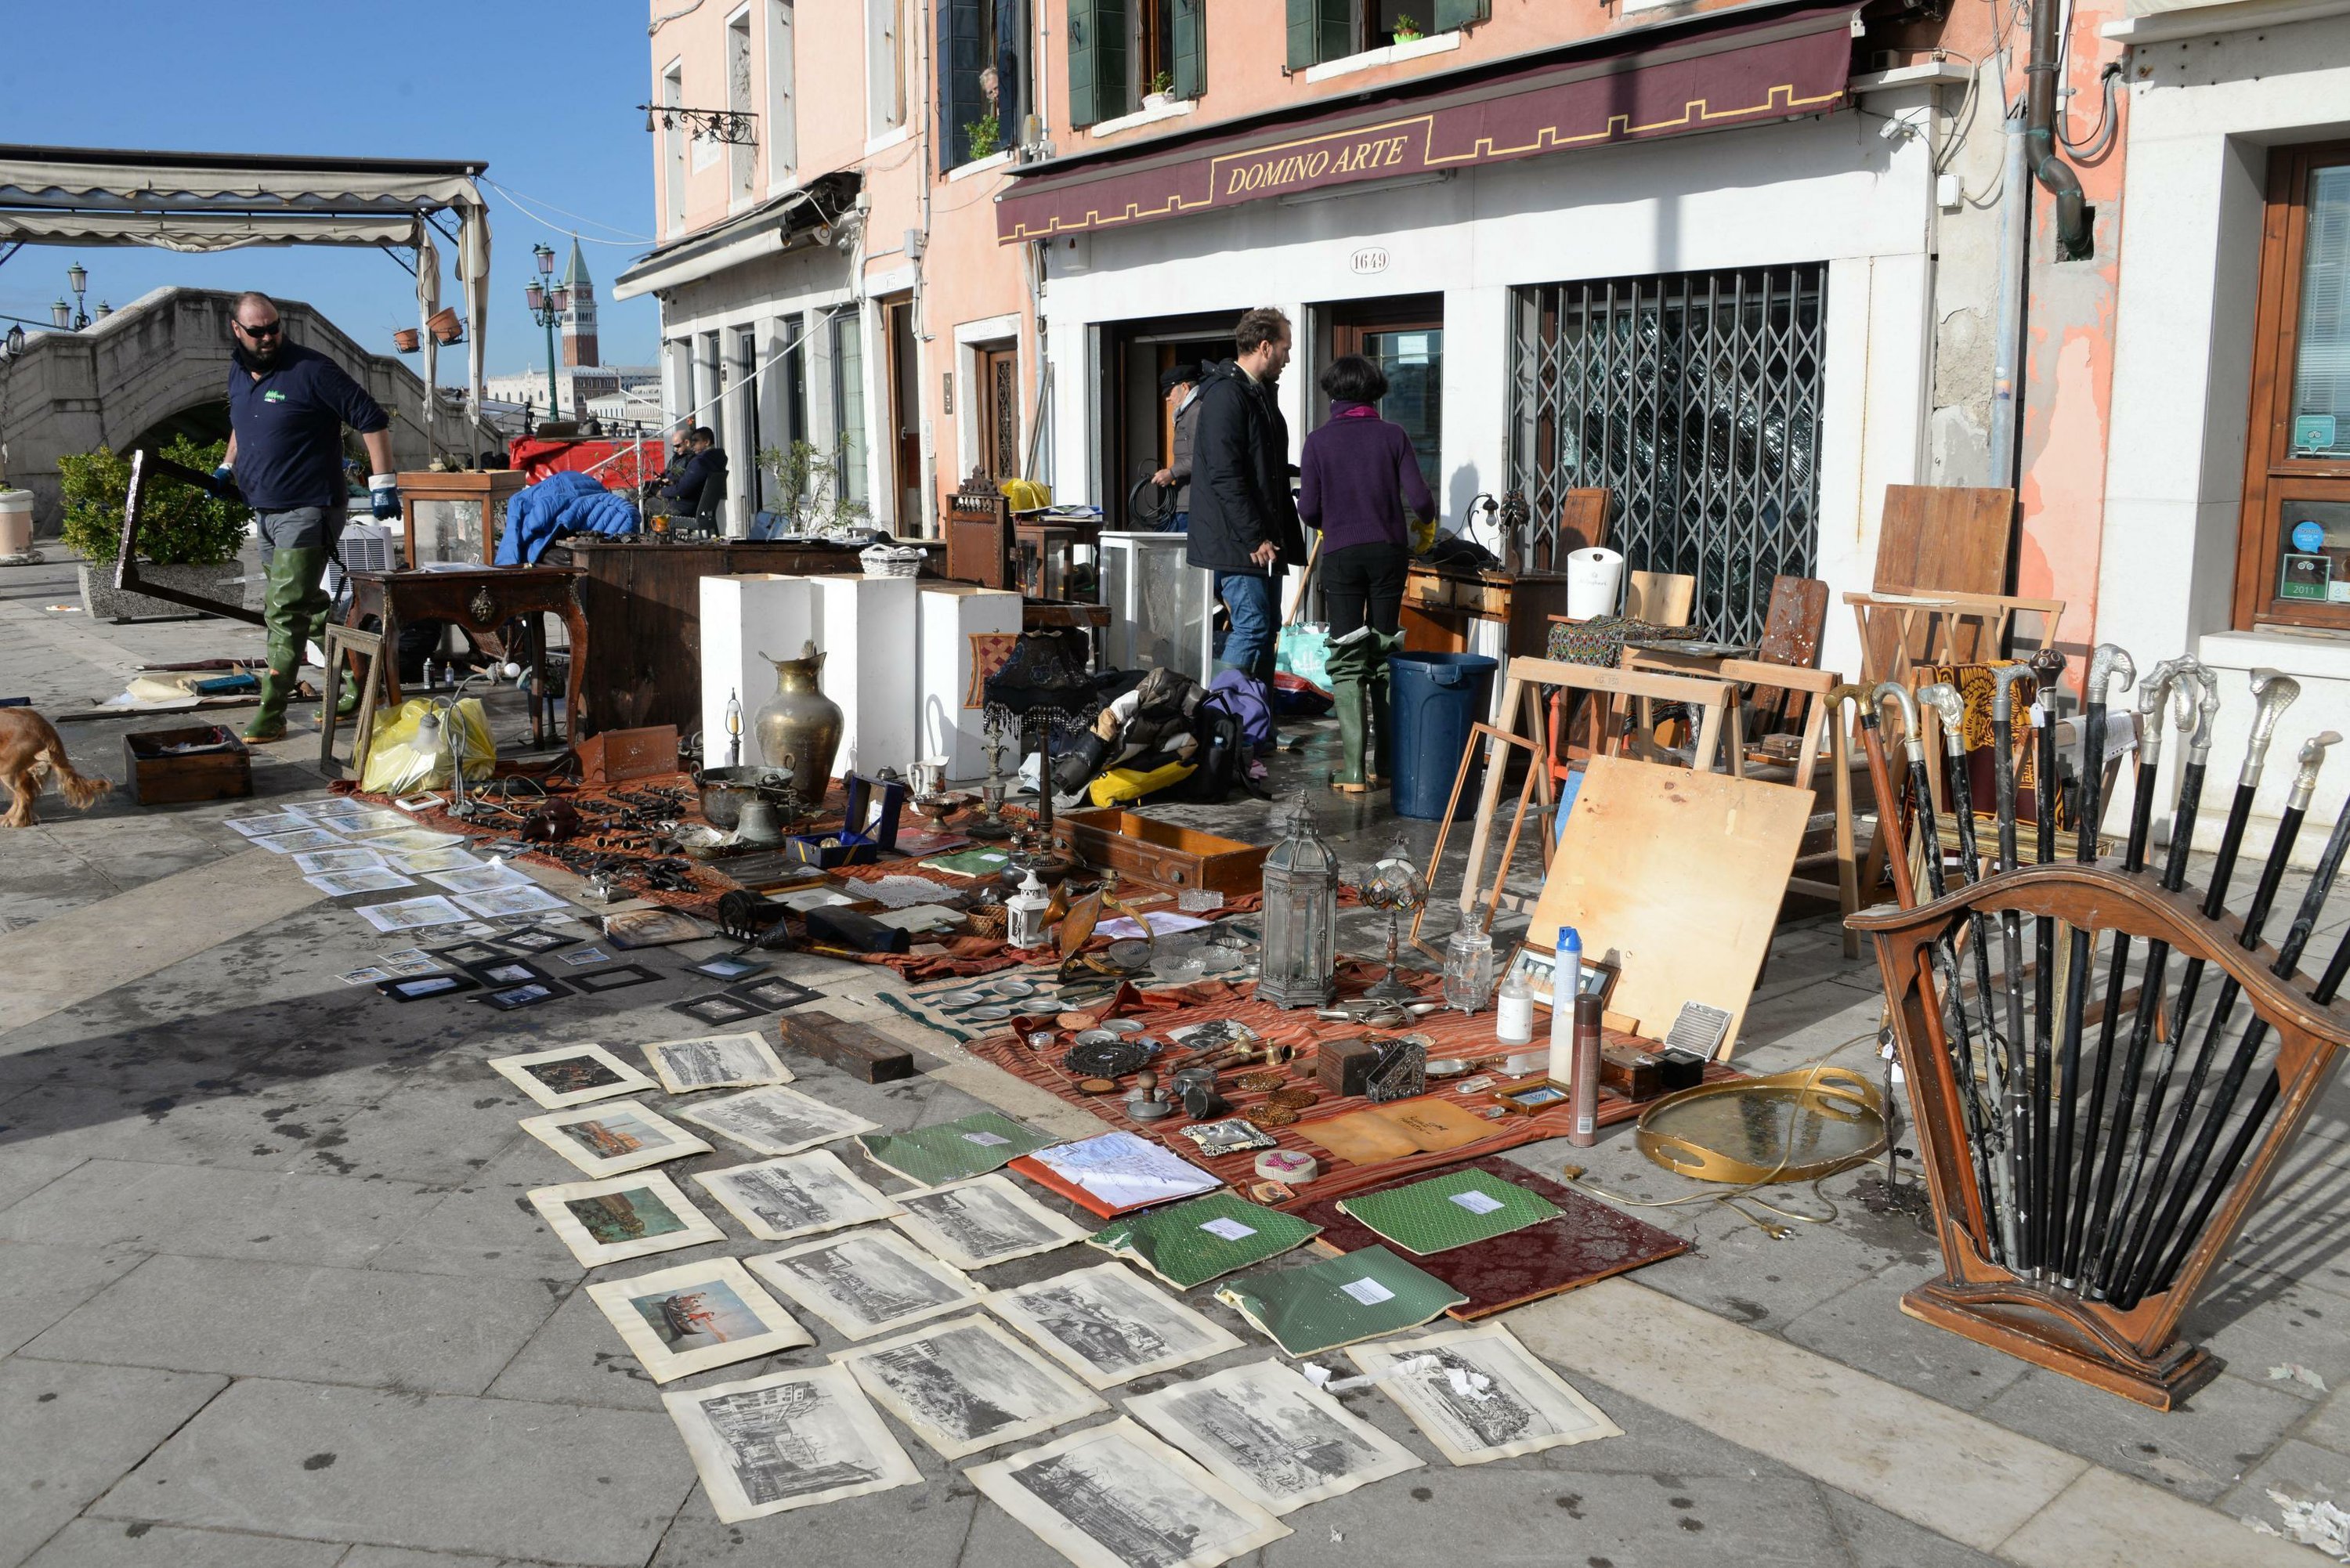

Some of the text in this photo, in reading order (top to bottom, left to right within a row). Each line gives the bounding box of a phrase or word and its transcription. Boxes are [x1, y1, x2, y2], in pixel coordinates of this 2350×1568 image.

[1226, 135, 1408, 195] DOMINO ARTE
[1354, 251, 1386, 269] 1649
[2293, 585, 2314, 595] 2011
